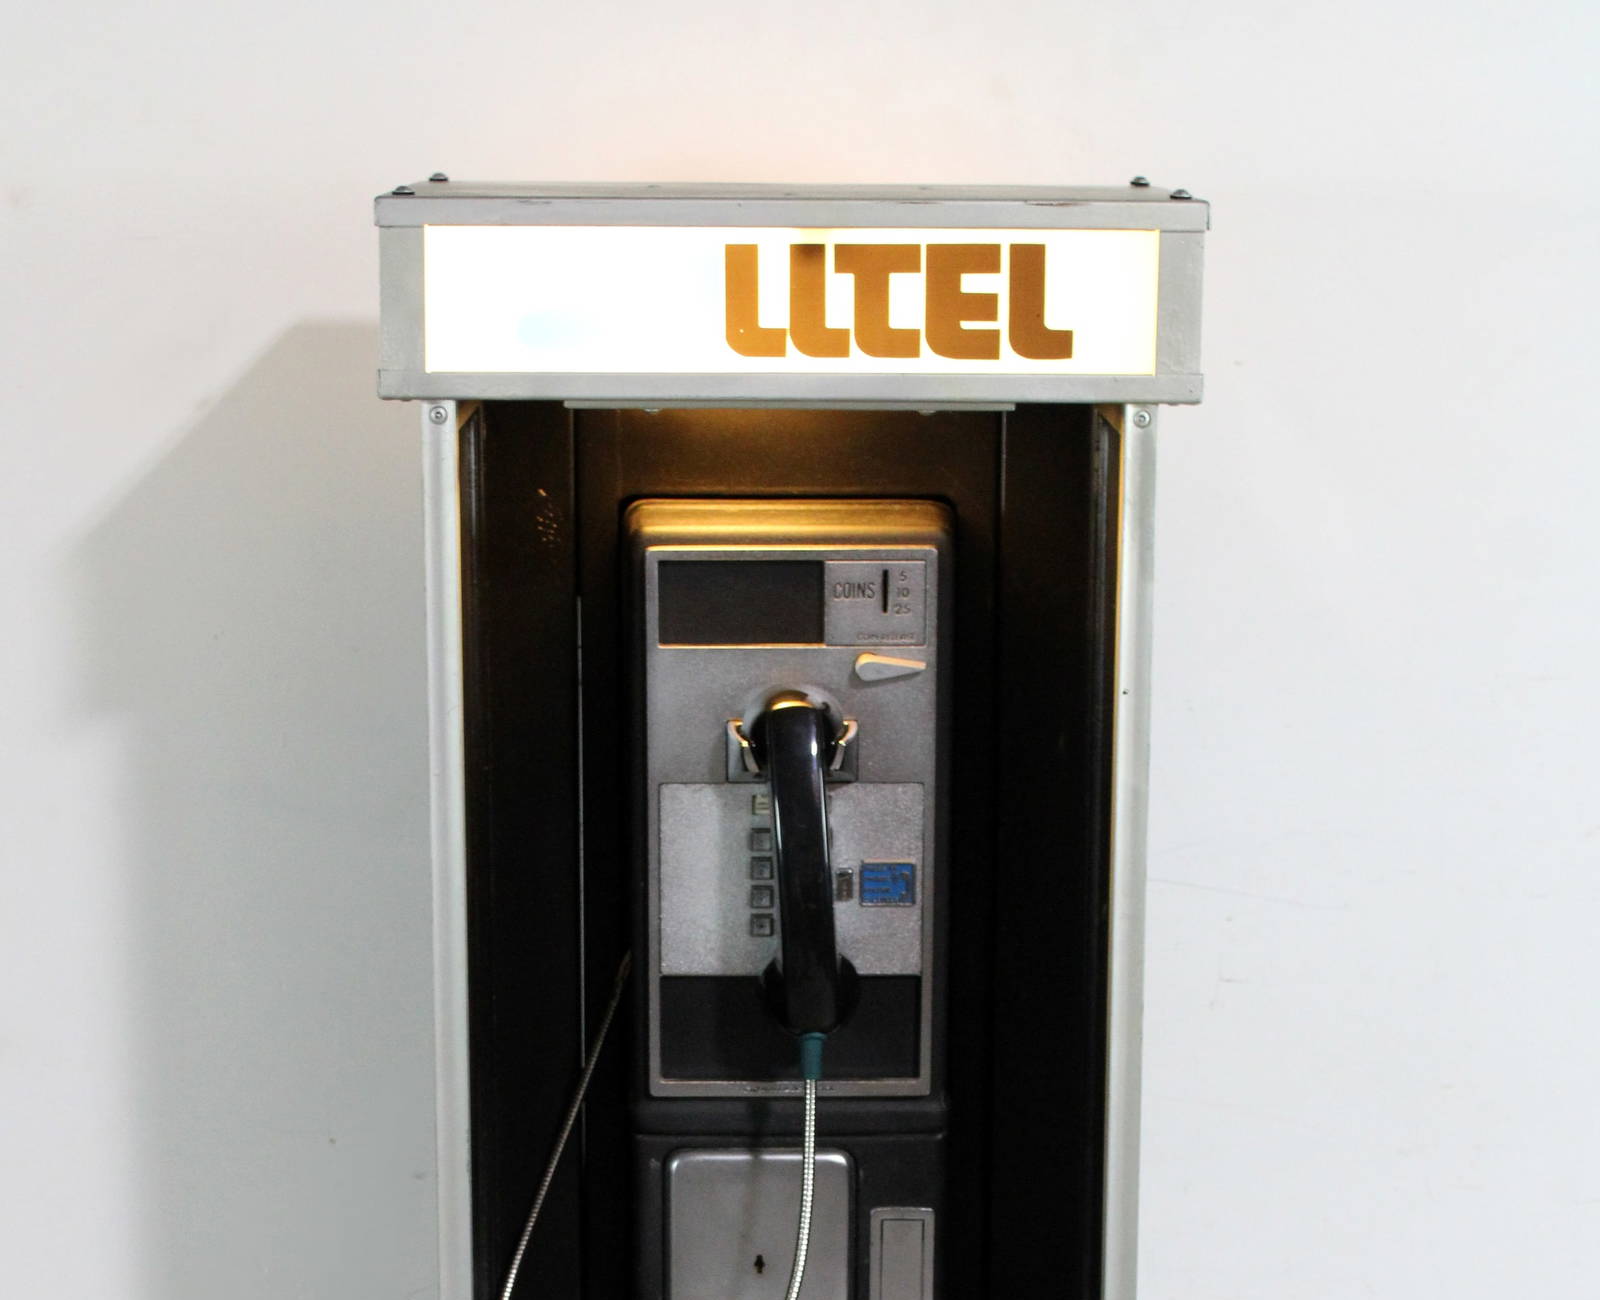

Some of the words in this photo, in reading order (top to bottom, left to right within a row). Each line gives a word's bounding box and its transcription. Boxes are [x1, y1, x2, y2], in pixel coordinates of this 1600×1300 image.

[900, 570, 908, 582] 5
[833, 582, 875, 600] COINS
[897, 587, 910, 599] 10
[895, 603, 911, 616] 25
